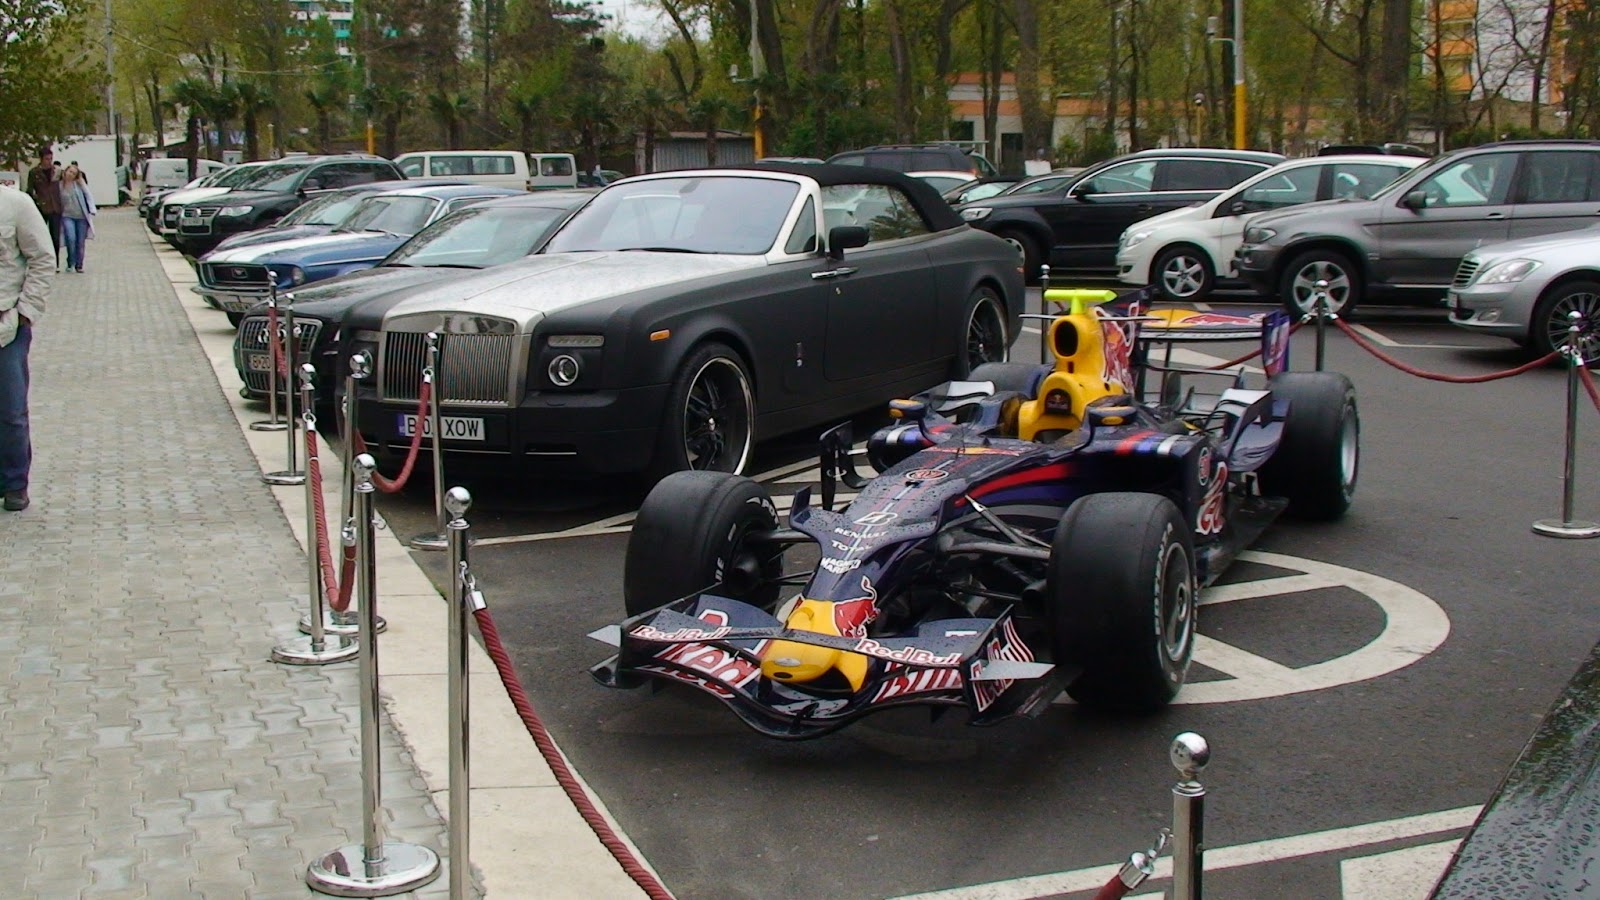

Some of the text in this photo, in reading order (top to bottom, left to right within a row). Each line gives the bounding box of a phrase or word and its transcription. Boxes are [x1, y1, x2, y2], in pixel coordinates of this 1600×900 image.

[445, 418, 479, 437] XOW
[834, 527, 889, 539] RENAULT
[831, 540, 873, 551] TOTAL
[629, 625, 732, 640] Red Bull
[854, 638, 963, 666] Red Bull
